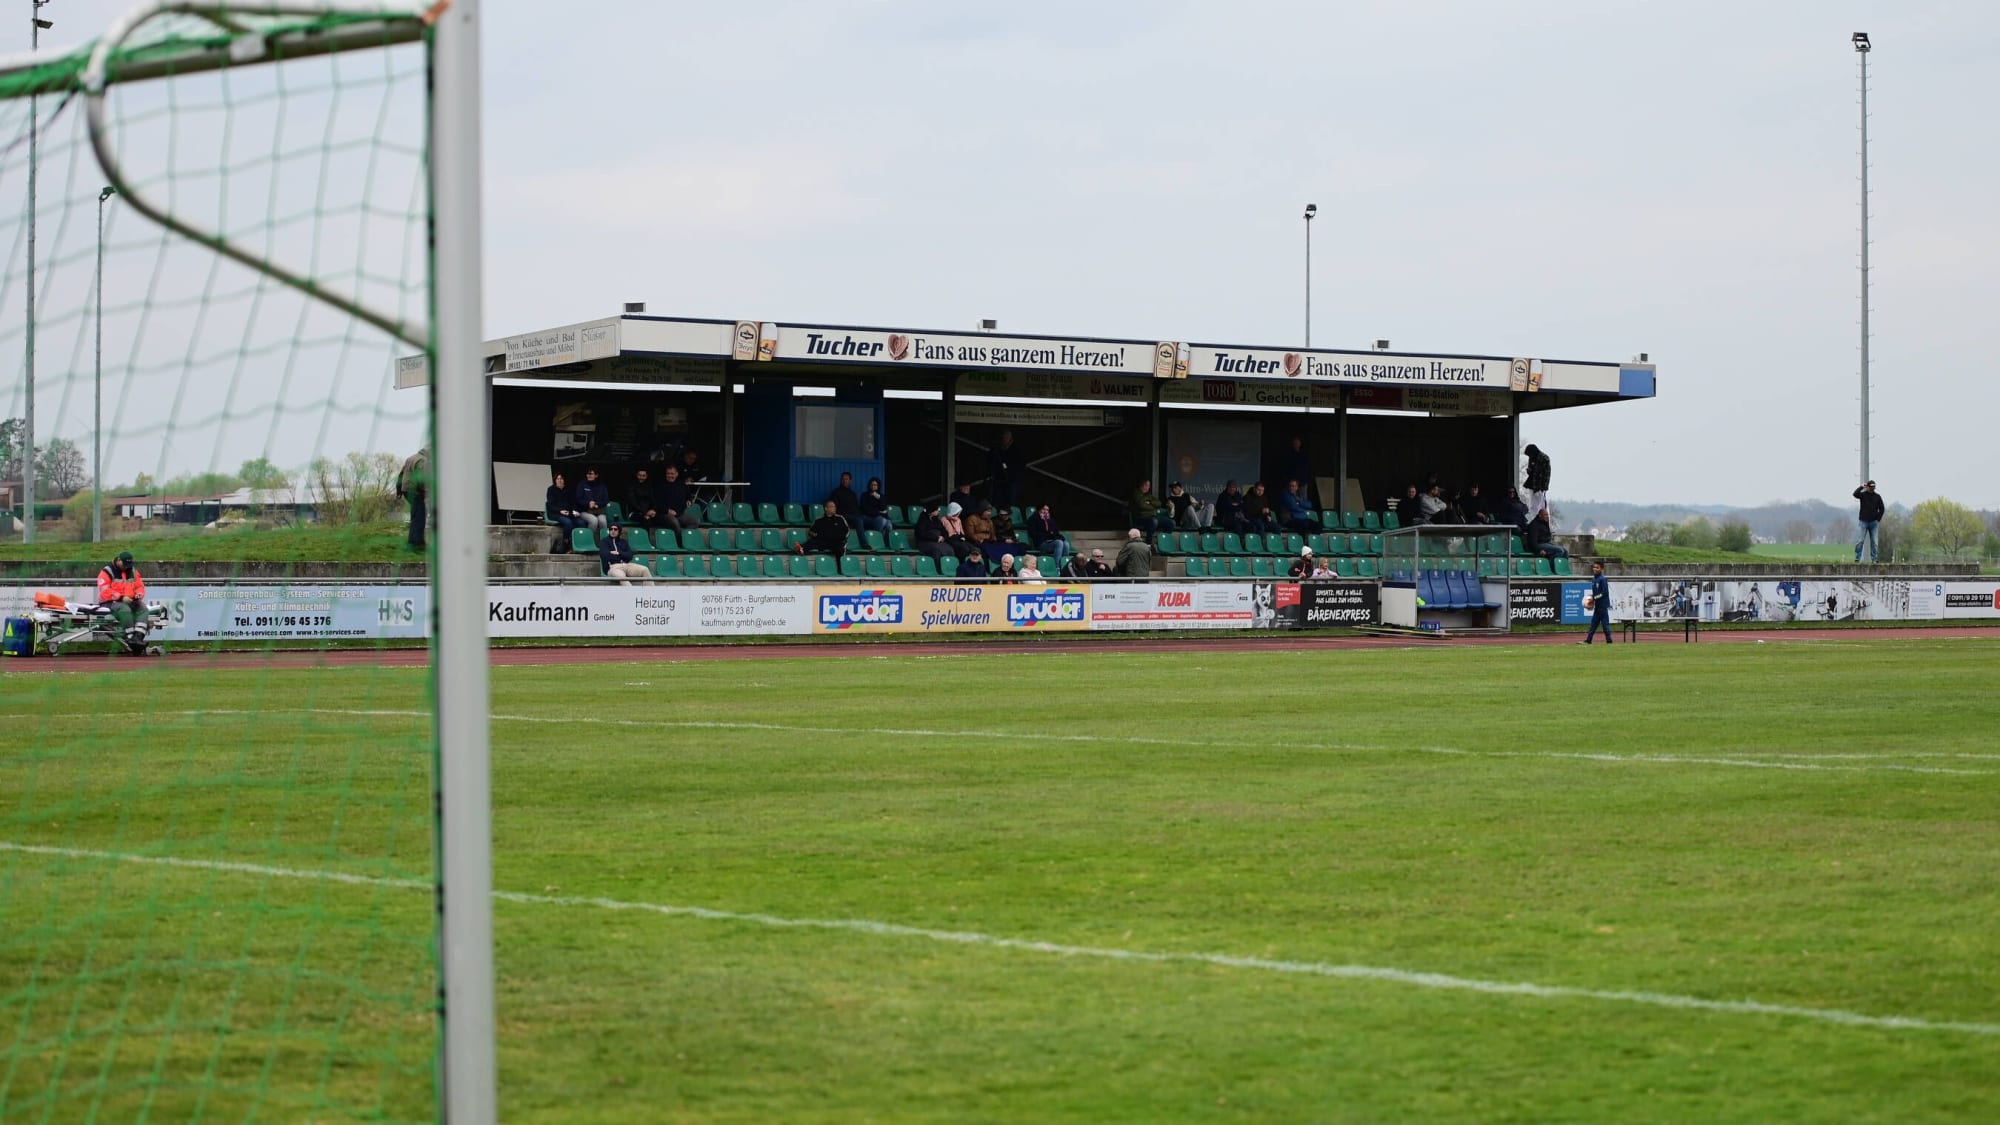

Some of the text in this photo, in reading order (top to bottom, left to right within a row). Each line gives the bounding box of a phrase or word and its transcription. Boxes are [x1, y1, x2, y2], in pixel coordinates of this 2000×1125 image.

[522, 338, 542, 349] Küche
[546, 333, 558, 345] und
[562, 331, 575, 343] Bad
[806, 333, 884, 357] Tucher
[914, 338, 1126, 368] Fans aus ganzem Herzen!
[1213, 352, 1280, 374] Tucher
[1306, 356, 1486, 382] Fans aus ganzem Herzen!
[1103, 383, 1145, 397] VALMET
[1206, 383, 1235, 400] TORO
[1256, 391, 1309, 405] Gechter
[198, 589, 274, 600] Sonderanlagenbau
[280, 590, 310, 601] System
[317, 590, 350, 598] Services
[701, 594, 723, 604] 90768
[724, 594, 743, 603] Fürth
[930, 587, 983, 602] BRUDER
[1157, 591, 1192, 608] KUBA
[261, 602, 277, 612] und
[279, 602, 331, 612] Klimatechnik
[635, 597, 676, 611] Heizung
[701, 606, 754, 617] (0911) 75 23 67
[822, 595, 899, 623] bruder
[1010, 594, 1081, 622] bruder
[488, 601, 616, 623] Kaufmann GmbH
[635, 613, 671, 626] Sanitär
[920, 609, 990, 629] Spielwaren
[1307, 606, 1371, 621] BÄRENEXPRESS
[235, 616, 331, 627] Tel. 0911/96 45 376
[701, 618, 787, 628] kaufmann.gmbh@web.de
[296, 629, 366, 637] www.h-s-services.com
